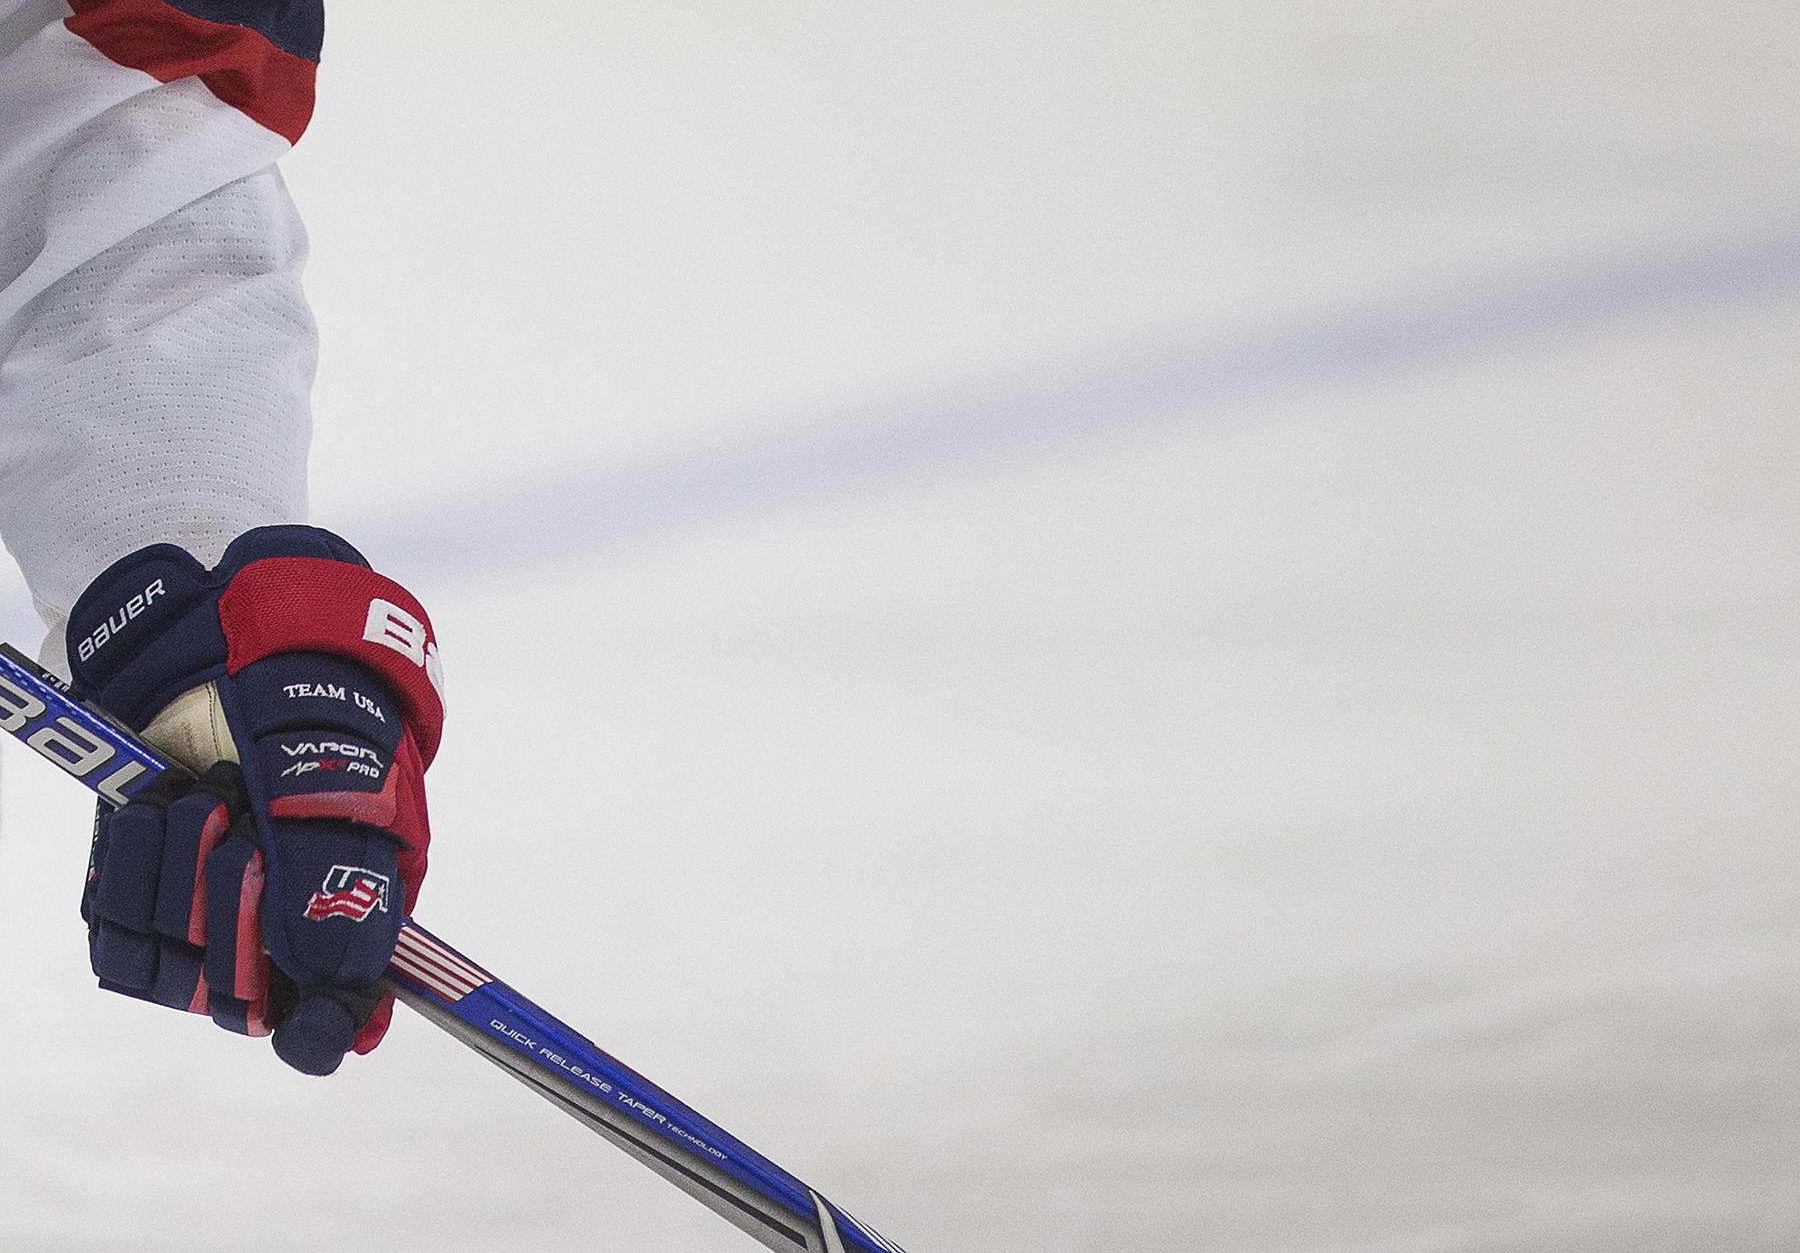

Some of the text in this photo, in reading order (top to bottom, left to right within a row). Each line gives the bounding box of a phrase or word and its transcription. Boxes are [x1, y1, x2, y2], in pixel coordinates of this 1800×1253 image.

[78, 578, 166, 662] BAUER
[283, 683, 387, 724] TEAM USA
[280, 741, 384, 769] VAPOR
[347, 761, 380, 779] PRO
[490, 1018, 729, 1161] QUICK RELEASE TAPER TECHNOLOGY
